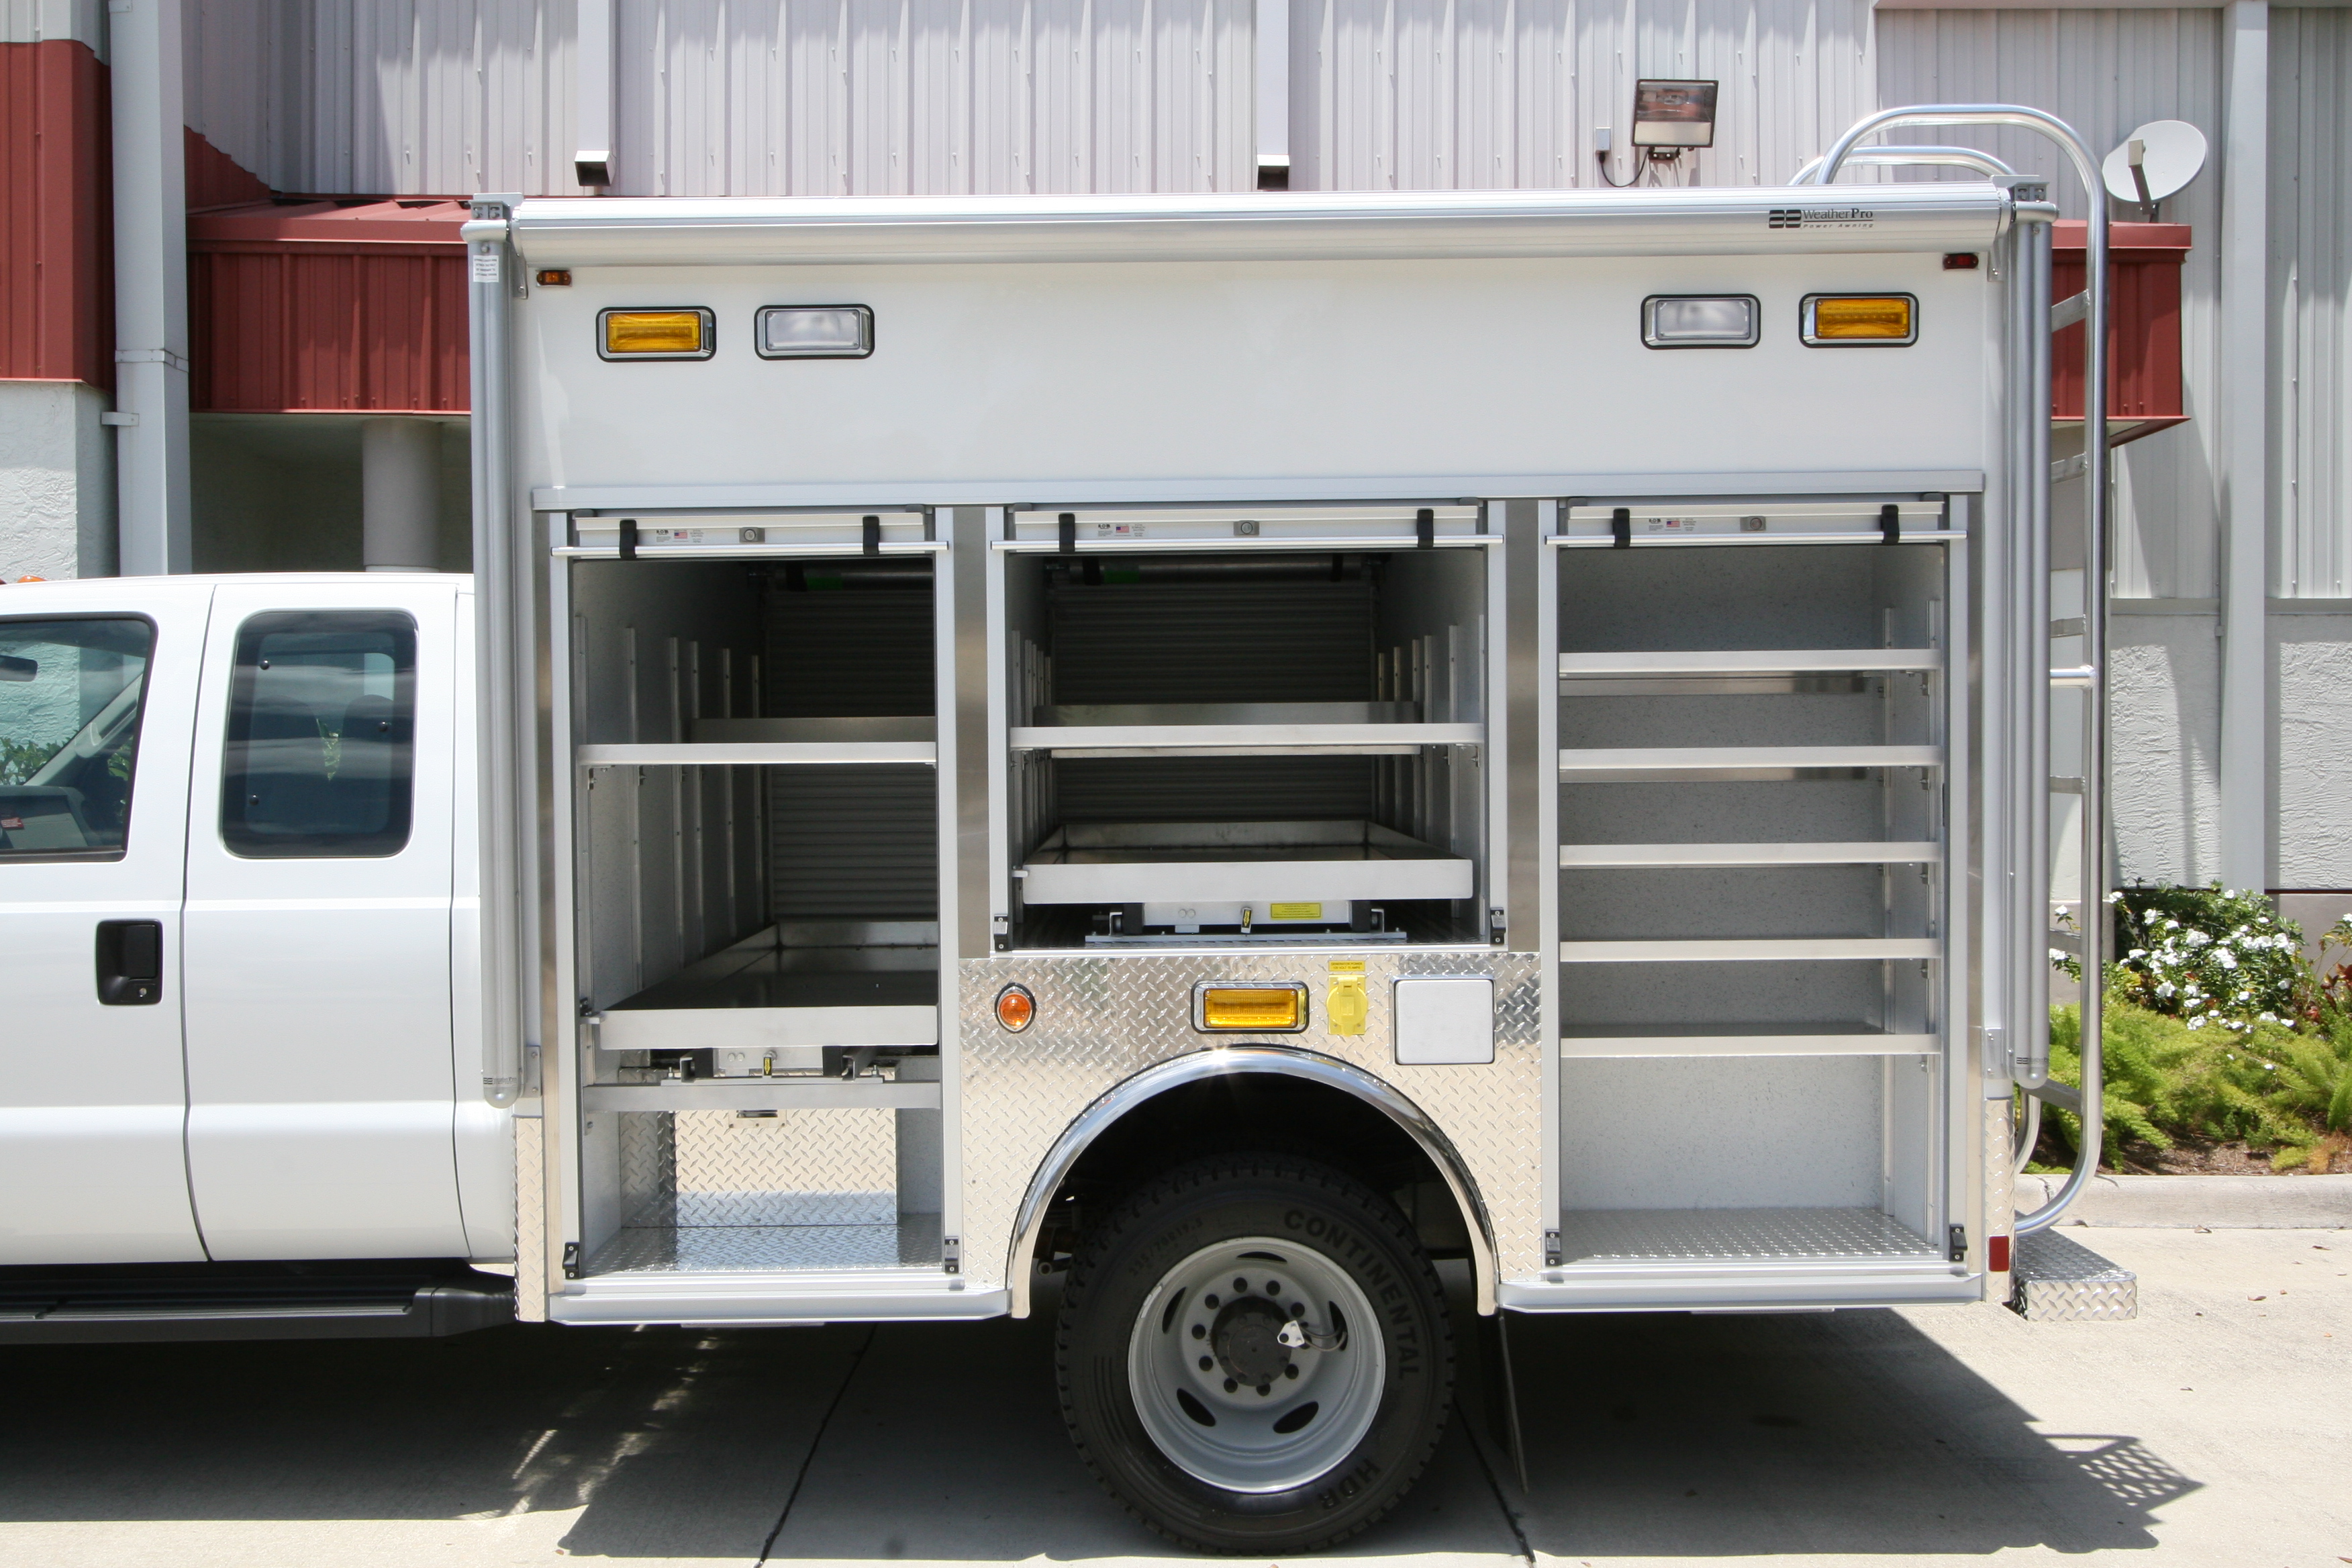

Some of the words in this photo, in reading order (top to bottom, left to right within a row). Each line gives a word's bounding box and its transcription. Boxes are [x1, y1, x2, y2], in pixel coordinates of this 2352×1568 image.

[1803, 208, 1873, 219] WeatherPro
[1284, 1209, 1419, 1379] CONTINENTAL
[1318, 1458, 1381, 1510] HDR
